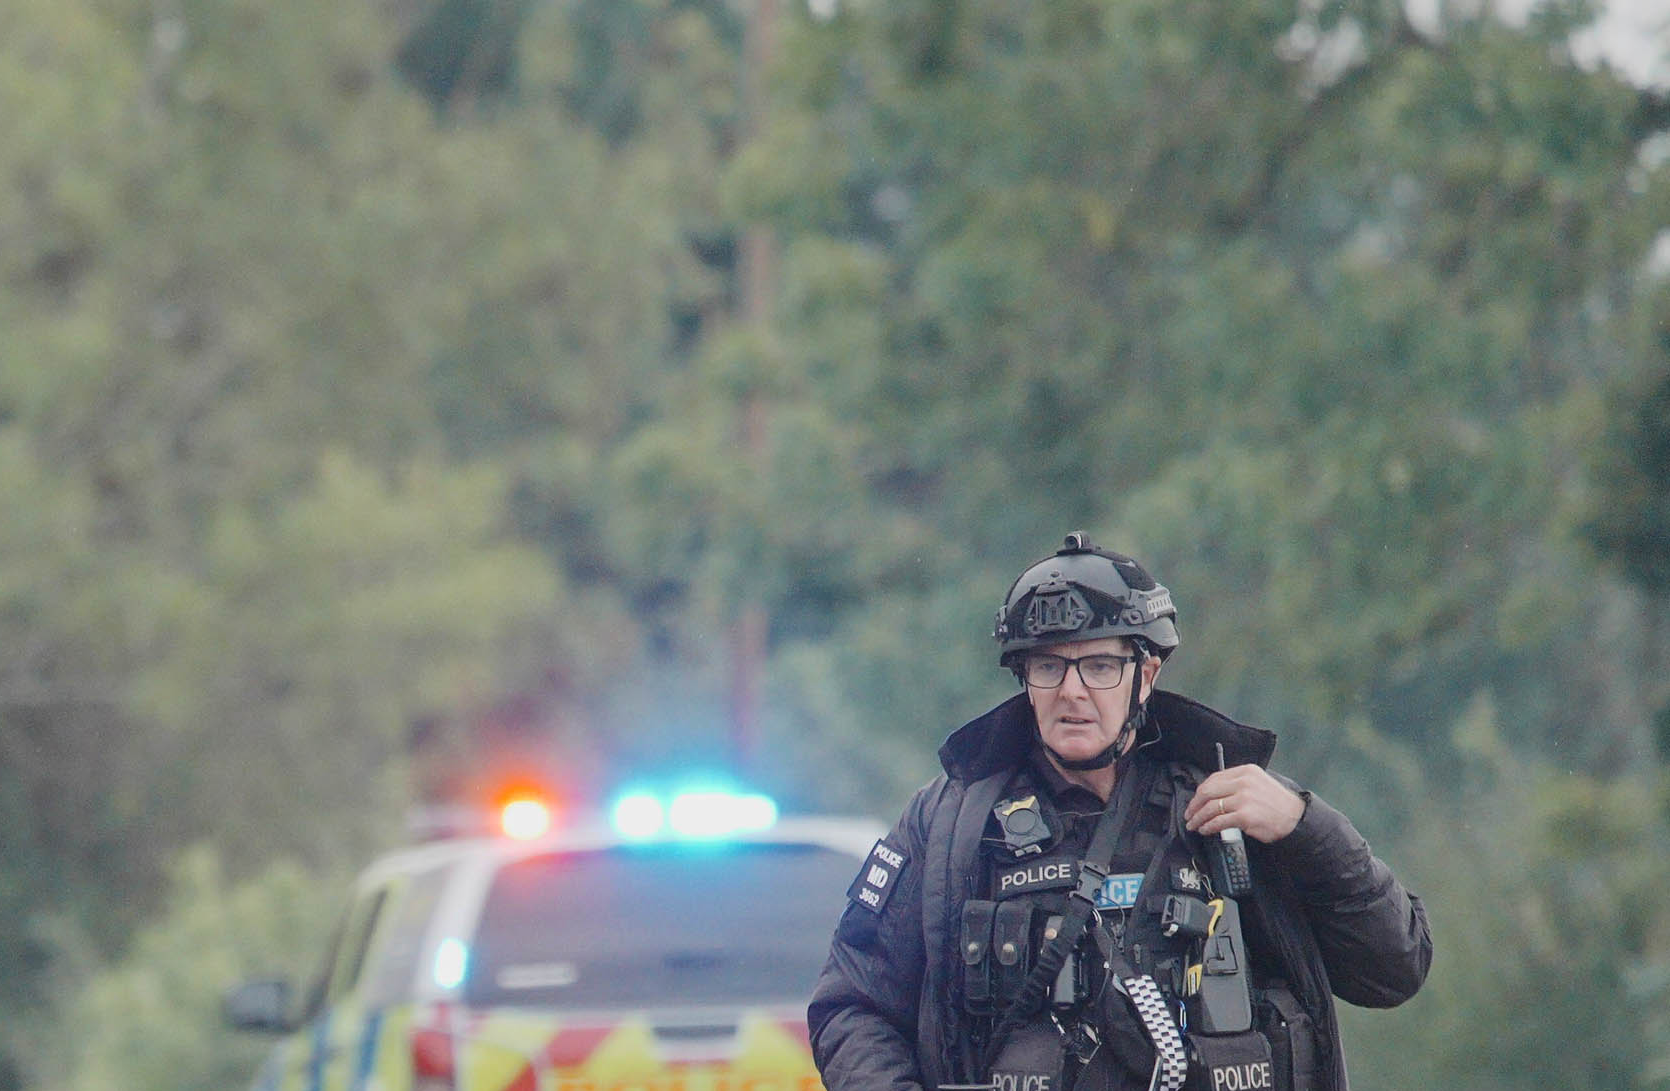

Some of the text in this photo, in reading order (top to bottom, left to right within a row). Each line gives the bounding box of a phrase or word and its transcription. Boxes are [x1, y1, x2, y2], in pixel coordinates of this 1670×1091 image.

[873, 844, 904, 869] POLICE
[866, 864, 889, 889] MD
[1001, 864, 1071, 890] POLICE
[1101, 880, 1138, 904] ICE
